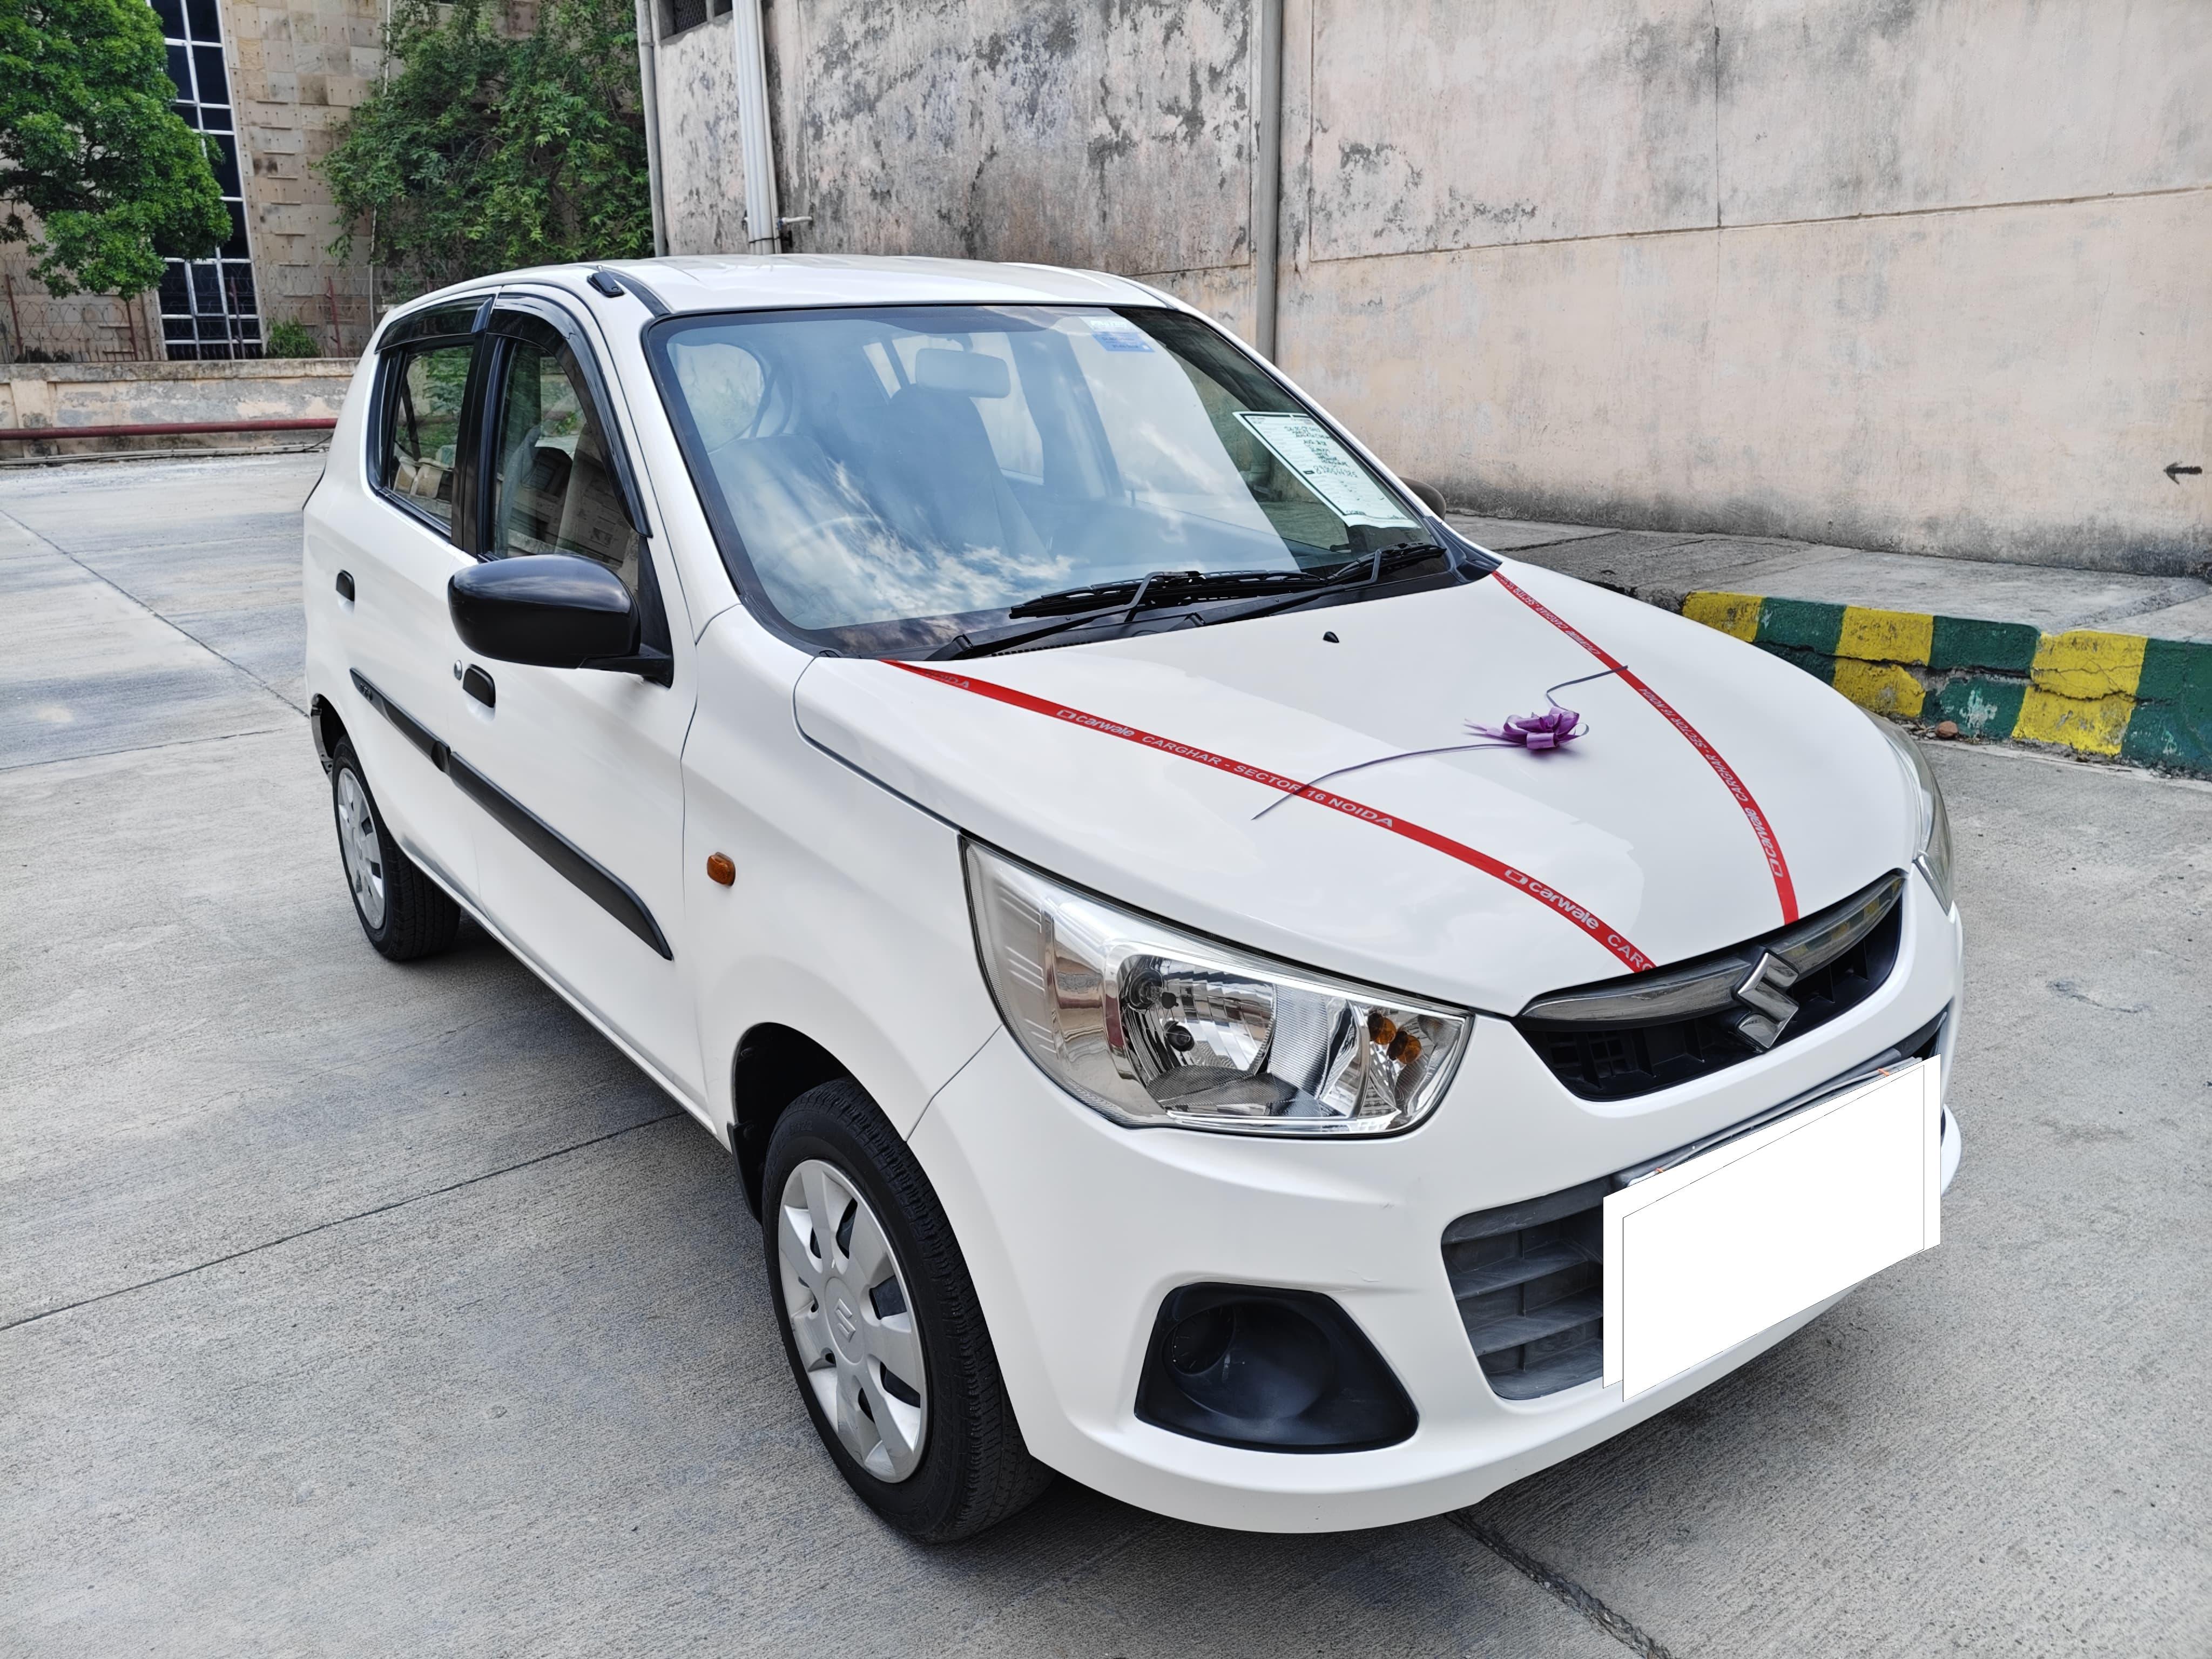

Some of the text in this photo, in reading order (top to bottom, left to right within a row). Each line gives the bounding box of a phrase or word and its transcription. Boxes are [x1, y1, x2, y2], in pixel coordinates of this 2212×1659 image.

[1661, 708, 1676, 716] 16
[1670, 718, 1707, 748] SECTOR
[1076, 715, 1135, 737] carwale
[1141, 736, 1222, 765] CARGHAR
[1233, 765, 1302, 791] SECTOR
[1307, 790, 1327, 801] 16
[1328, 798, 1393, 827] NOIDA
[1705, 754, 1748, 802] CARGHAR
[1745, 807, 1777, 859] carwale
[1529, 881, 1600, 929] carwale
